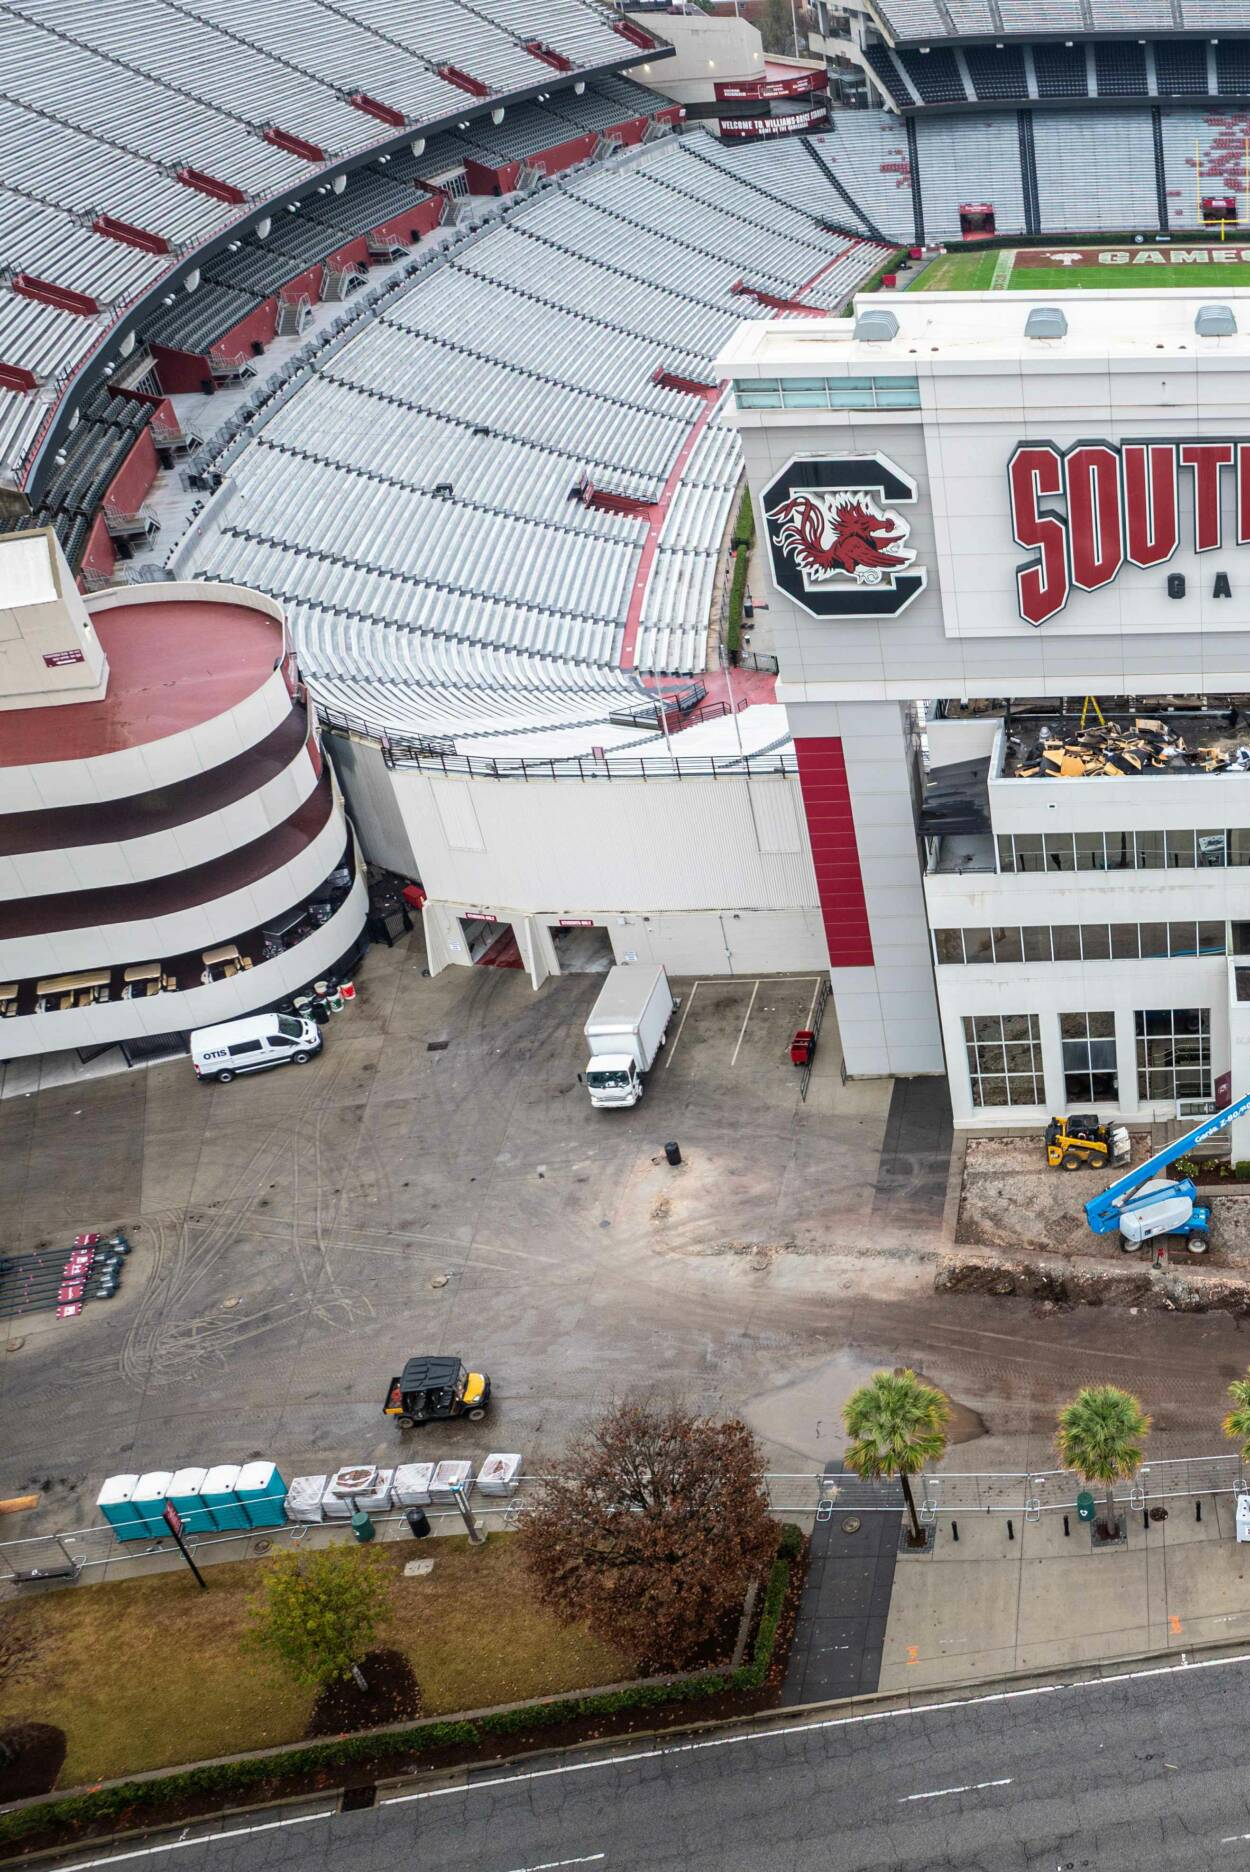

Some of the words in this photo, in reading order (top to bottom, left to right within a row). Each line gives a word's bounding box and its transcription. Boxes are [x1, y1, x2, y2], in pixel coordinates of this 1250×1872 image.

[721, 120, 753, 130] WELCOME
[754, 120, 764, 129] TO
[203, 1049, 227, 1061] OTIS
